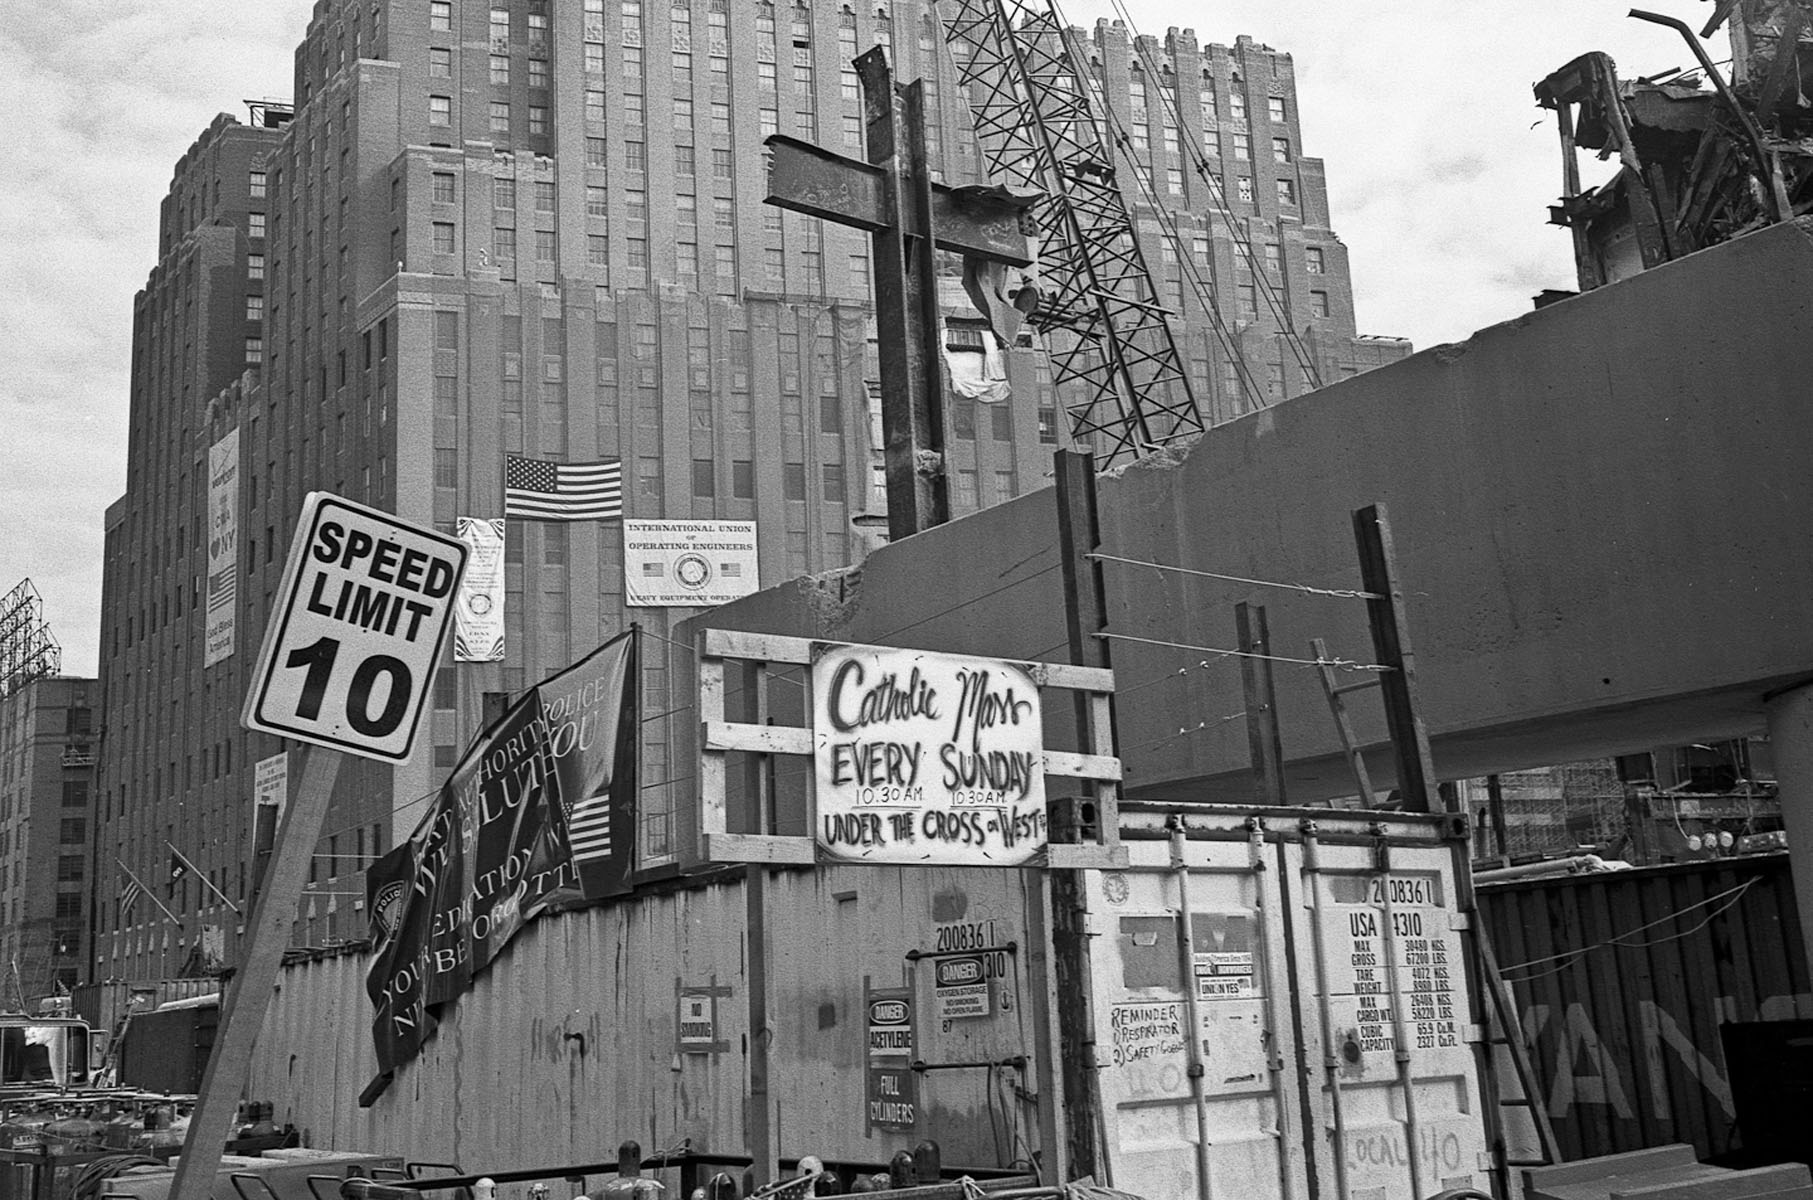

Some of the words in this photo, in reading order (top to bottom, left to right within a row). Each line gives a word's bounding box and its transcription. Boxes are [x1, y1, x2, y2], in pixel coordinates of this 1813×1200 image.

[629, 524, 715, 533] INTERNATIONAL
[718, 525, 752, 533] UNION
[692, 543, 753, 551] ENGINEERS
[313, 521, 454, 599] SPEED
[307, 571, 433, 643] LIMIT
[285, 636, 412, 738] 10
[543, 676, 605, 721] POLICE
[827, 658, 942, 733] Catholic
[952, 669, 1032, 754] Mass
[832, 741, 921, 787] EVERY
[940, 743, 1033, 801] SUNDAY
[462, 738, 557, 855] SLUTE
[825, 812, 886, 847] UNDER
[887, 811, 915, 844] THE
[922, 810, 986, 847] CROSS
[997, 805, 1041, 848] WEST
[1349, 912, 1377, 937] USA
[1354, 940, 1371, 952] MAX
[1351, 953, 1376, 966] GROSS
[1406, 952, 1429, 965] 67200
[942, 962, 977, 980] DANGER
[1355, 969, 1374, 981] TARE
[936, 988, 960, 998] OXYGEN
[960, 985, 987, 996] STORAGE
[1225, 983, 1239, 994] YES
[1353, 981, 1382, 994] WEIGHT
[691, 1003, 701, 1016] NO
[1359, 996, 1377, 1008] MAX
[875, 1003, 904, 1020] DANGER
[1111, 1005, 1179, 1028] REMINDER
[1357, 1009, 1379, 1022] CARGO
[681, 1022, 711, 1038] SMOKING
[943, 1019, 953, 1033] 87
[1360, 1025, 1383, 1038] CUBIC
[870, 1030, 912, 1049] ACETYLENE
[1360, 1038, 1394, 1052] CAPACITY
[880, 1075, 900, 1095] FULL
[870, 1101, 914, 1124] CYLINDERS
